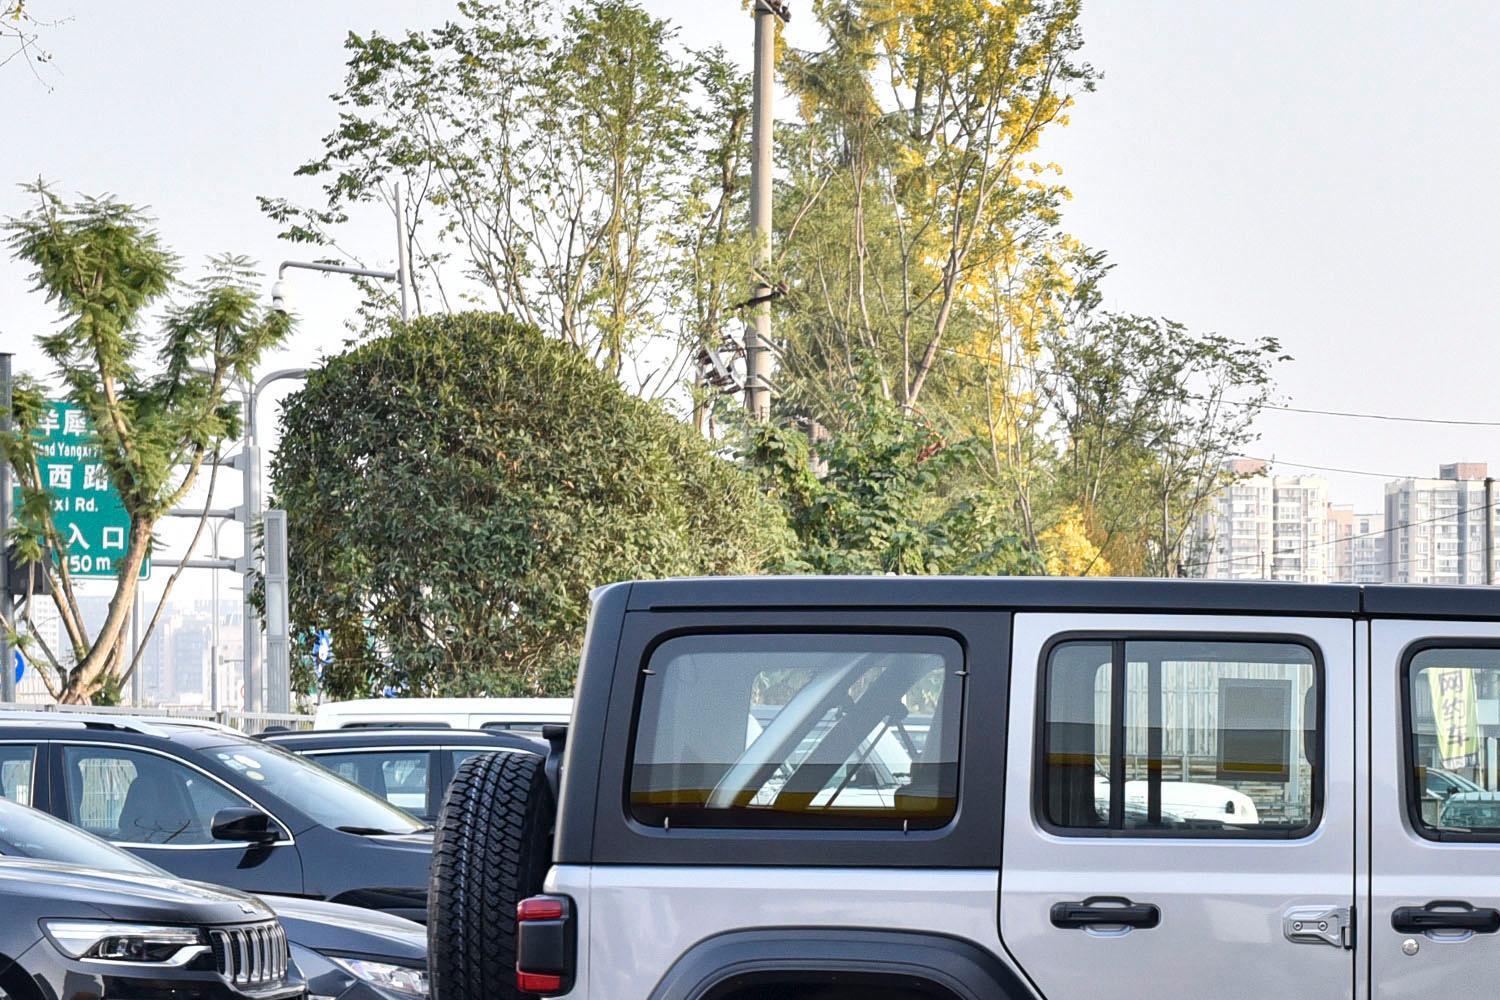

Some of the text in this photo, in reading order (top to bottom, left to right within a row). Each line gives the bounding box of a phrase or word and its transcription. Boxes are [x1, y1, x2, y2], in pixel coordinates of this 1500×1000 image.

[50, 496, 99, 512] xi Rd.
[66, 522, 124, 550] 入口
[1439, 671, 1470, 747] 网约车
